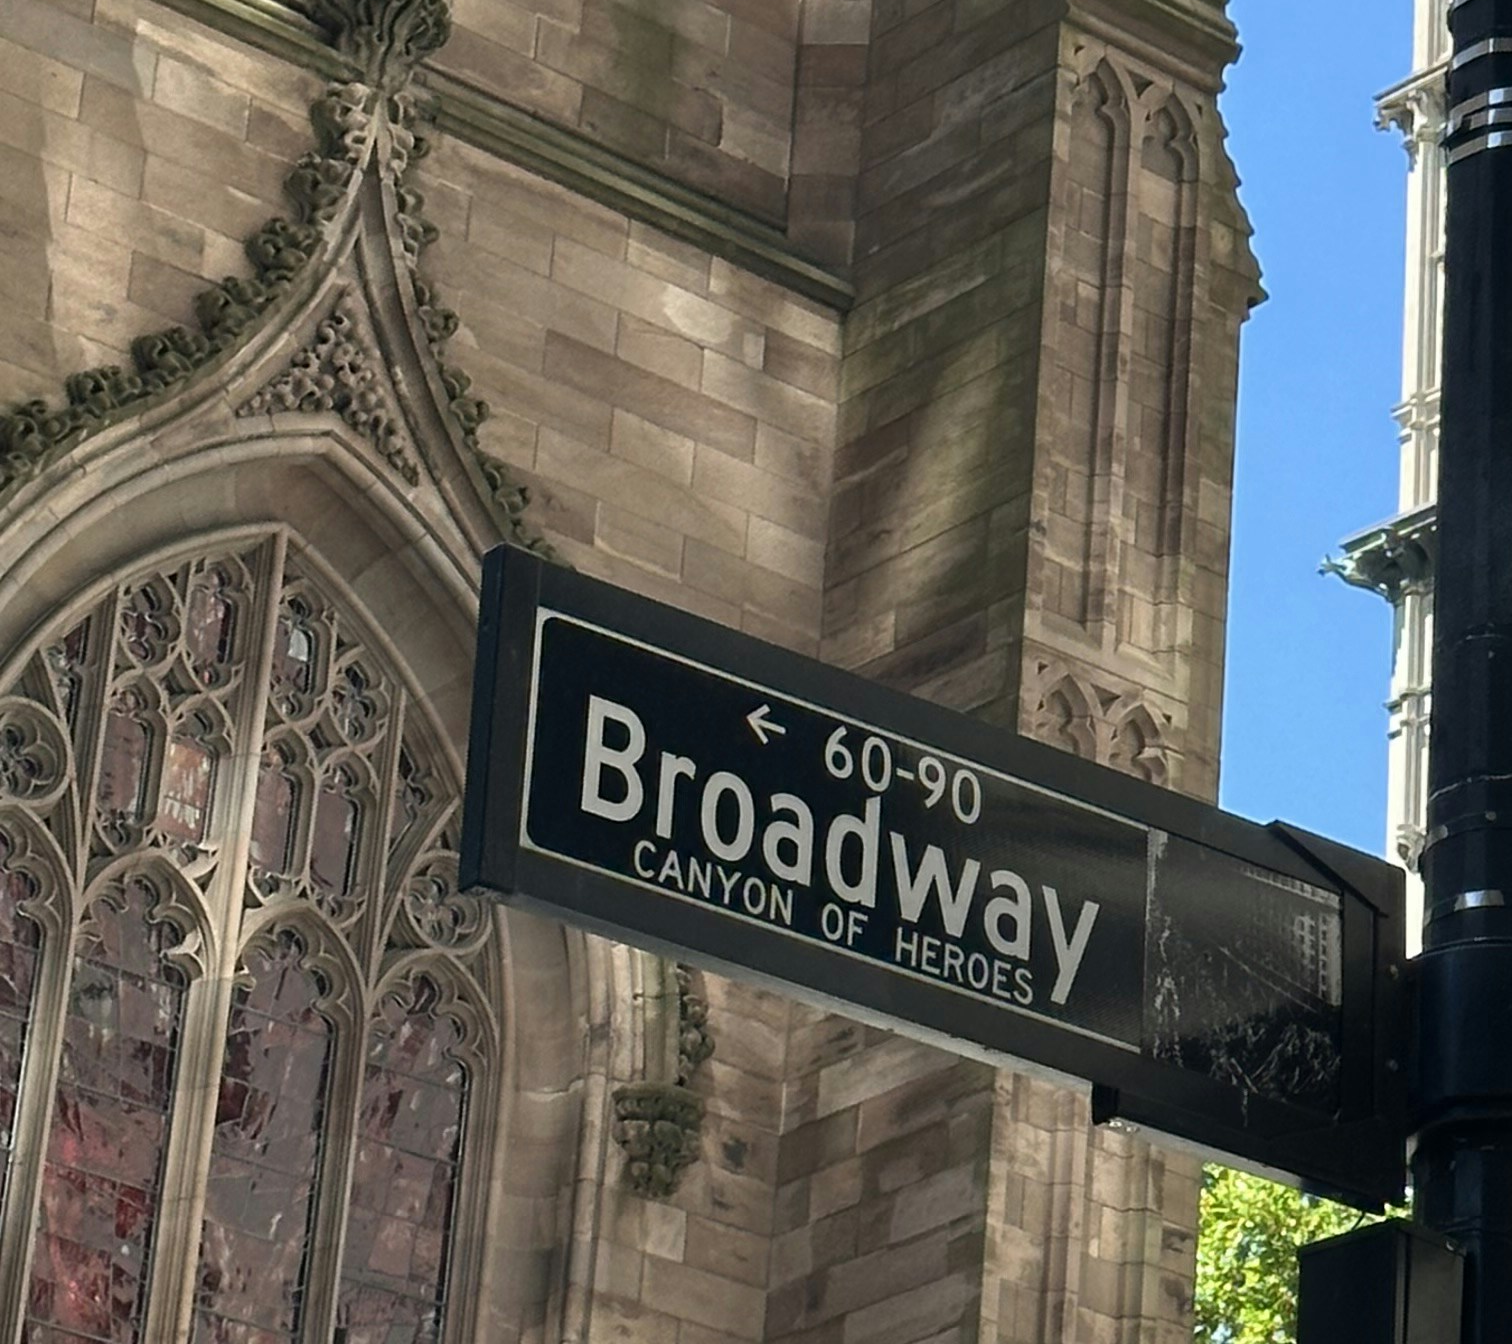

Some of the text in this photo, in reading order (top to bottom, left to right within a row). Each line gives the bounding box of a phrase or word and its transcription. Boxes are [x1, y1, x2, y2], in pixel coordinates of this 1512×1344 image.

[580, 693, 1101, 1006] Broadway
[823, 724, 982, 826] 60-90
[632, 839, 1034, 1006] CANYON OF HEROES
